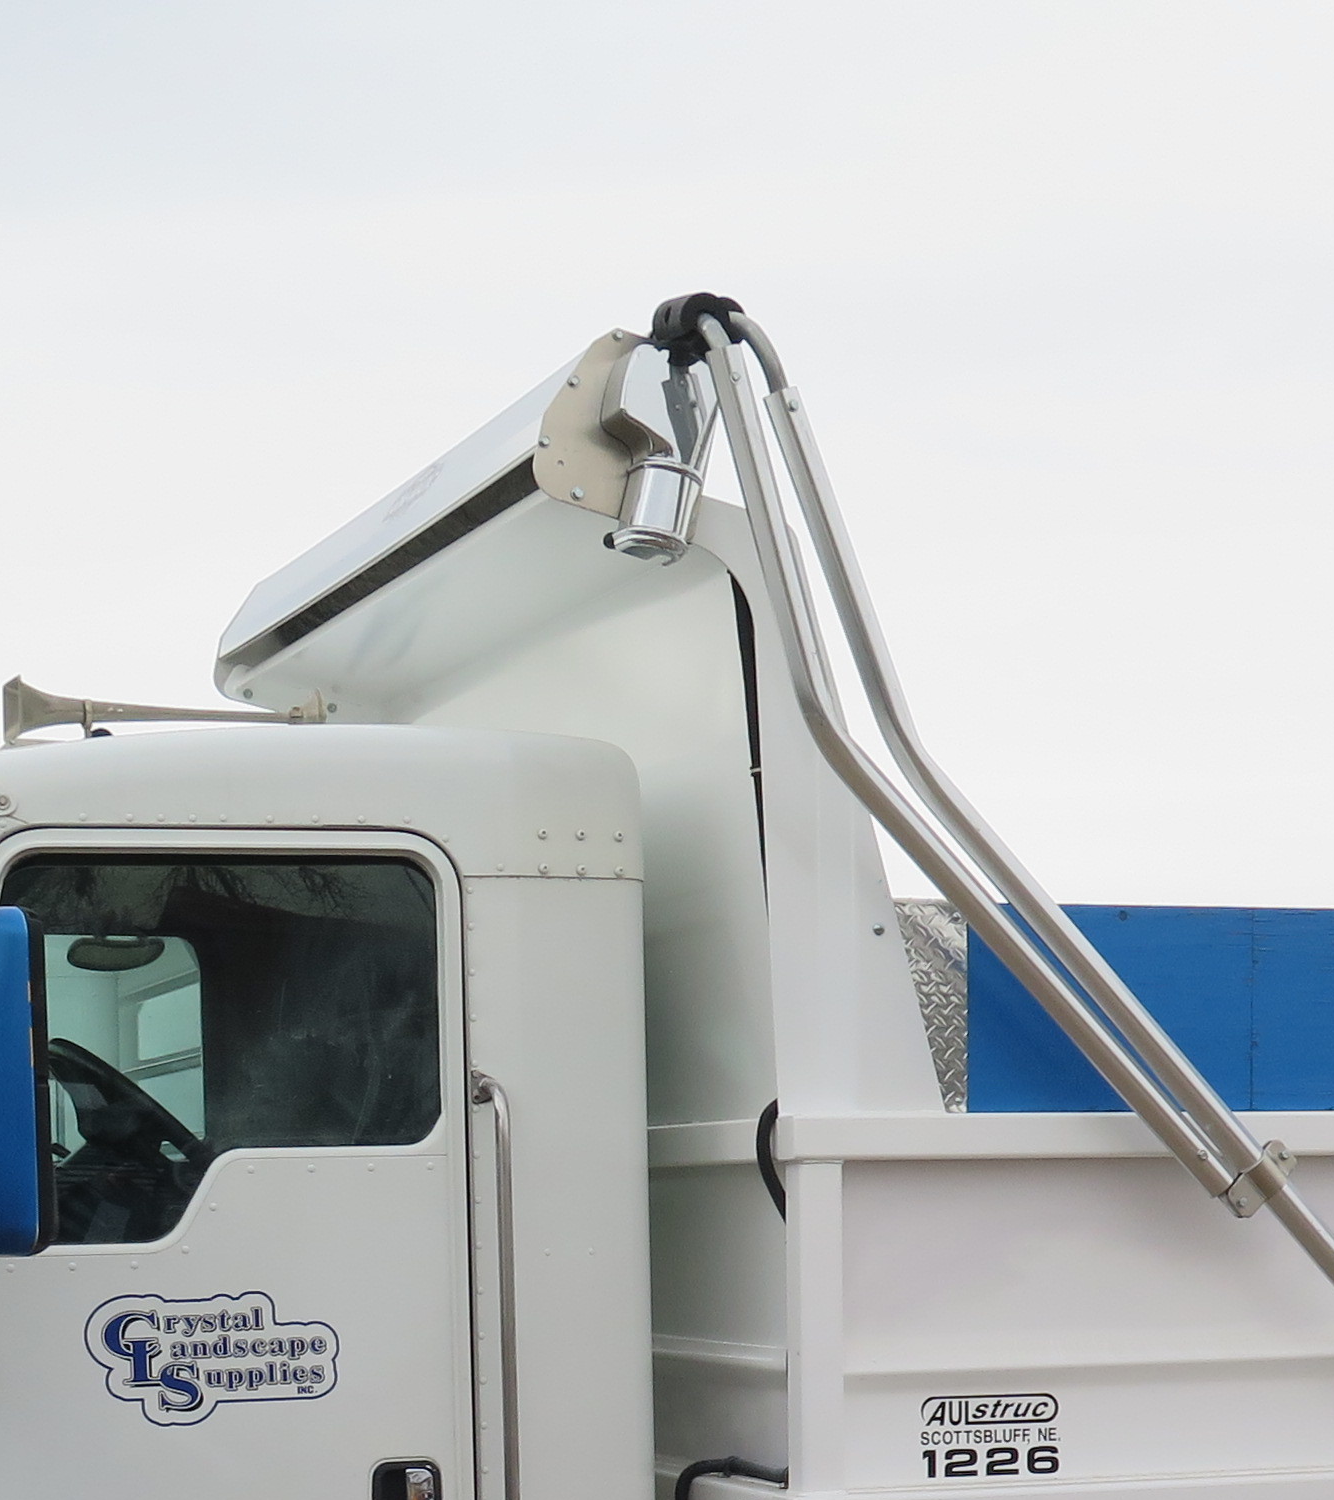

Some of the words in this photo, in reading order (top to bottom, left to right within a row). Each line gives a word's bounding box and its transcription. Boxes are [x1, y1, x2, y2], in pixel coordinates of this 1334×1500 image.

[102, 1308, 264, 1358] Crystal
[122, 1334, 327, 1387] Landscape
[158, 1361, 326, 1412] Supplies
[920, 1428, 1031, 1446] SCOTTSBLUFF,
[1037, 1427, 1061, 1442] NE.
[922, 1445, 1060, 1478] 1226
